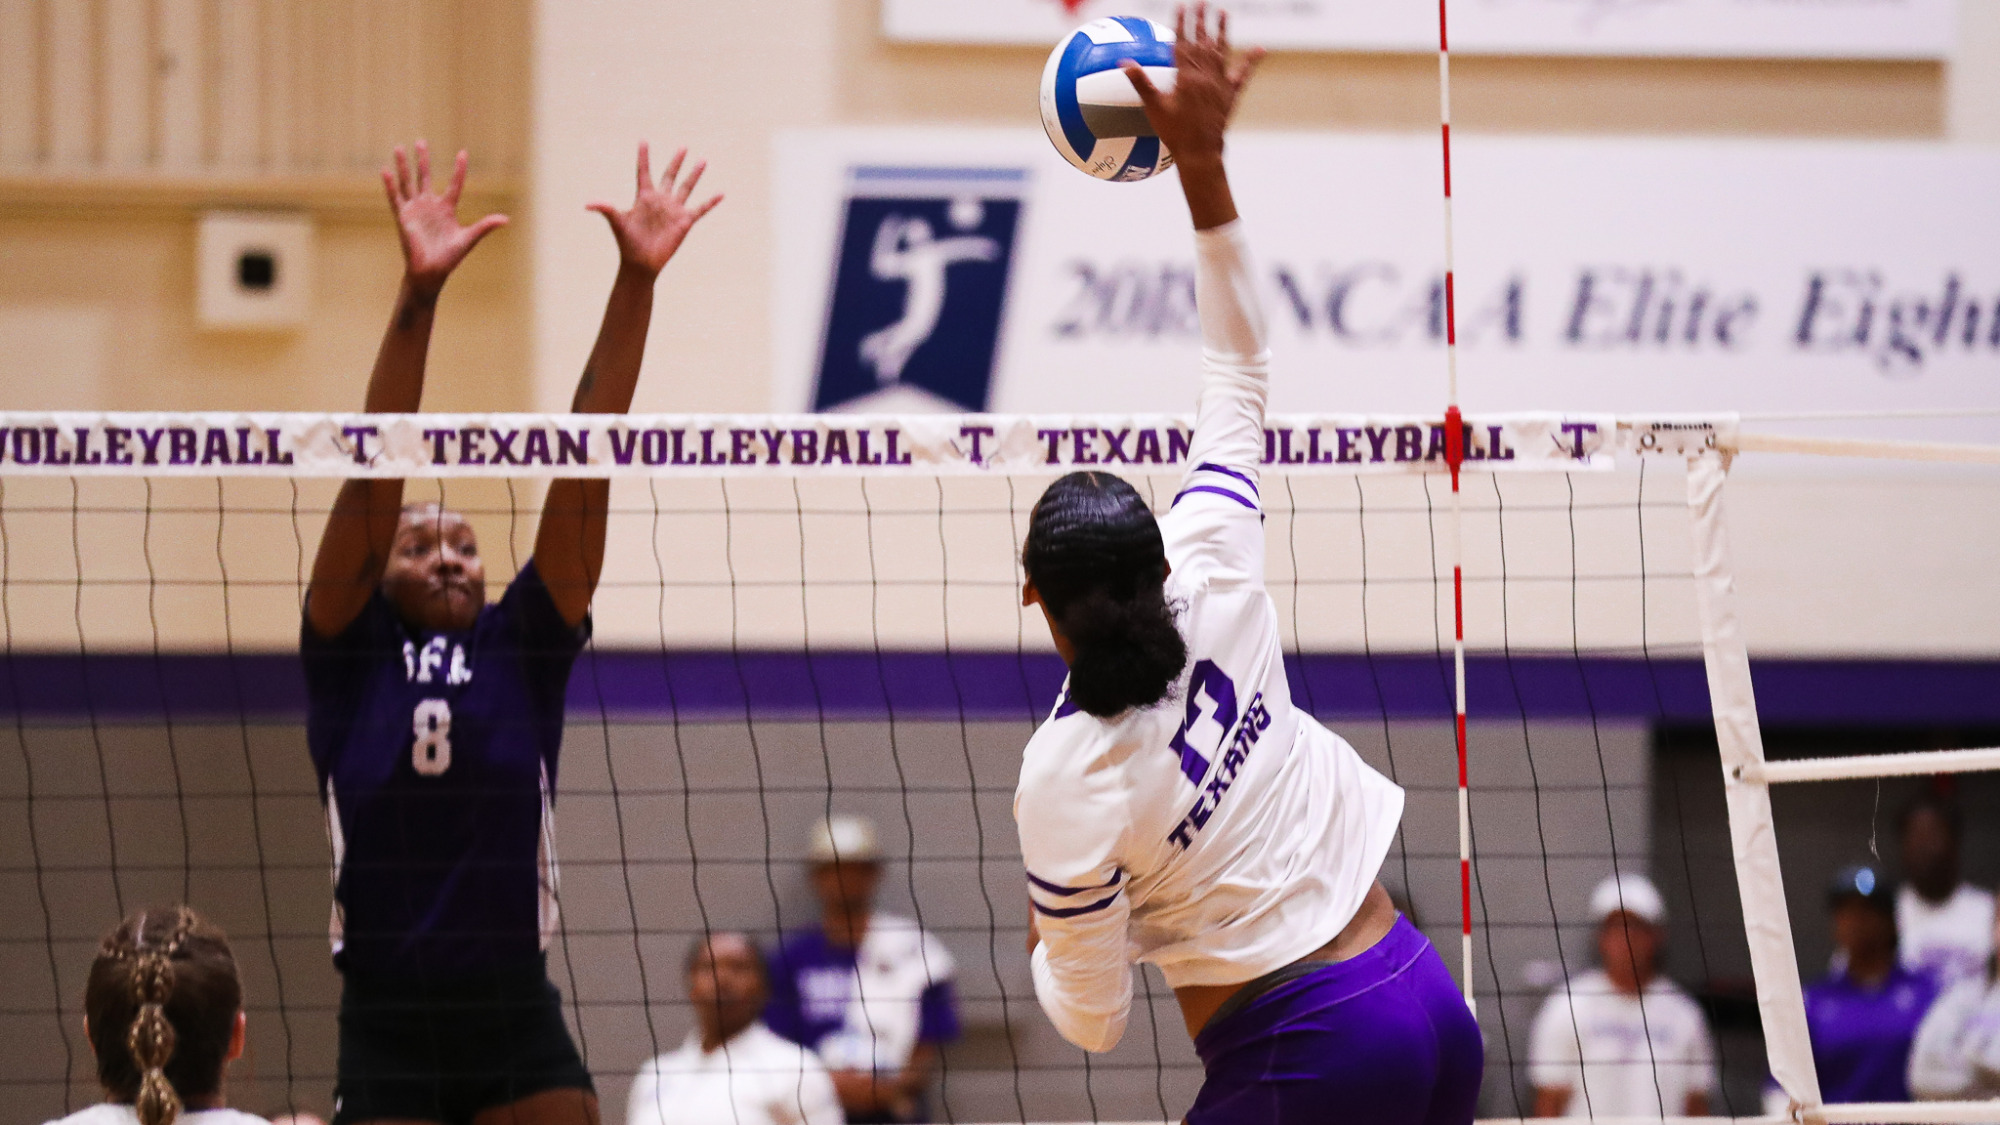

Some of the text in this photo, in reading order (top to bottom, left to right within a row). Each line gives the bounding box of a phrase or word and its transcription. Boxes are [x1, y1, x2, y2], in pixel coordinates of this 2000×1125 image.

[1274, 262, 1524, 342] NCAA
[1564, 268, 1760, 348] Elite
[424, 428, 590, 466] TEXAN
[607, 428, 911, 466] VOLLEYBALL
[1037, 428, 1195, 465] TEXAN
[1260, 424, 1515, 464] OLLEYBALL
[412, 698, 451, 776] 8
[1166, 691, 1271, 851] TEXANS
